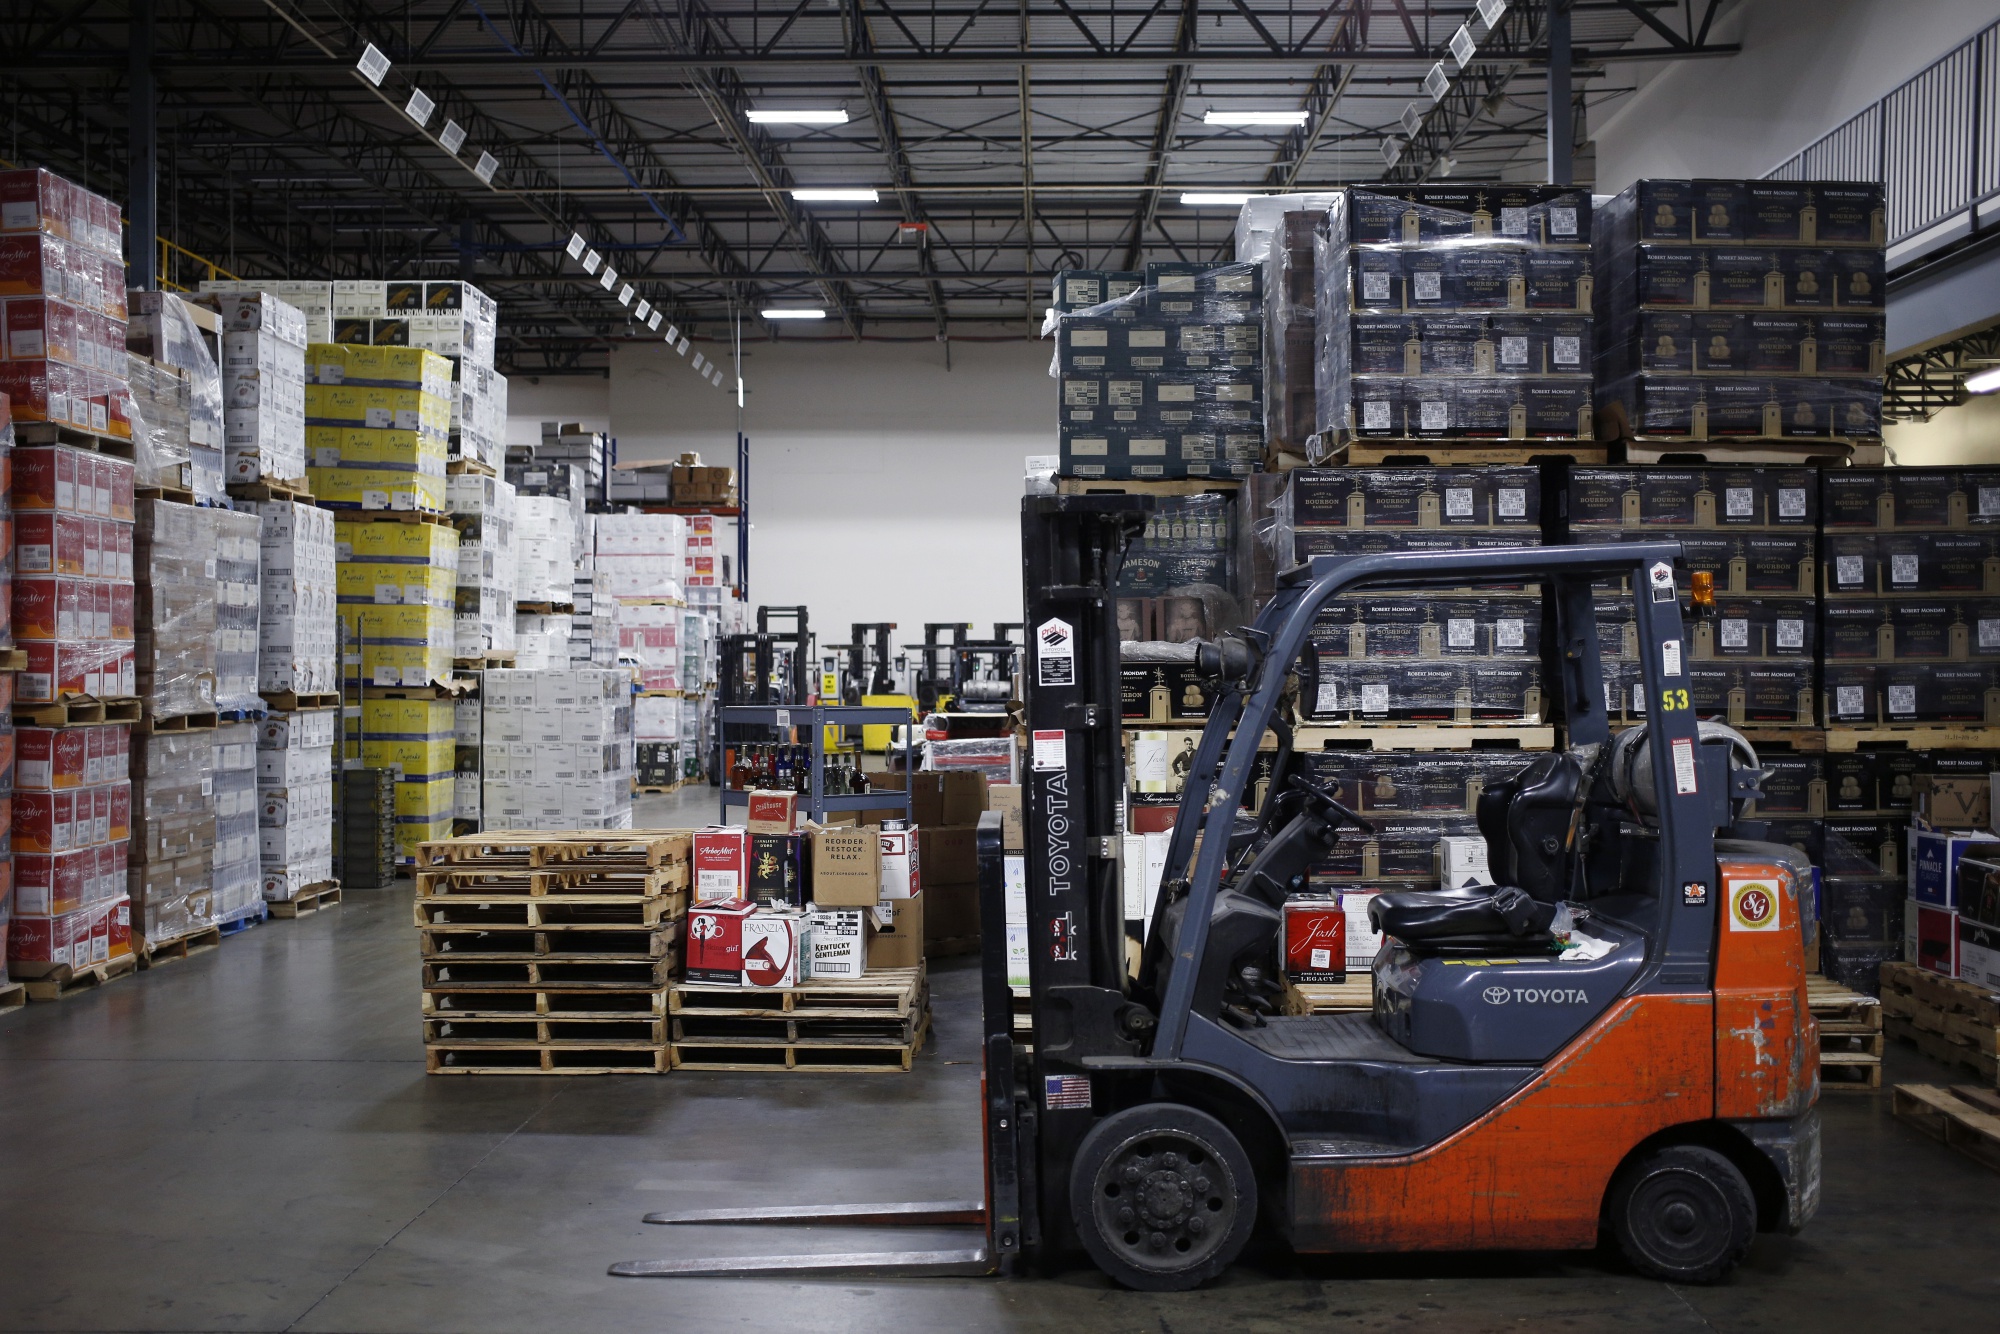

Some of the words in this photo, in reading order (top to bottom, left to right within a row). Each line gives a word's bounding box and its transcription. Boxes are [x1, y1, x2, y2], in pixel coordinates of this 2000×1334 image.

[387, 309, 404, 317] OLD
[404, 309, 422, 317] CROW
[426, 309, 442, 317] OLD
[443, 309, 461, 317] CROW
[461, 539, 481, 548] CROW
[1122, 559, 1160, 569] JAMESON
[458, 613, 479, 621] CROW
[458, 698, 479, 707] CROW
[1662, 689, 1689, 711] 53
[1954, 791, 1980, 814] V
[1047, 772, 1070, 896] TOYOTA
[1920, 859, 1941, 873] PINNACLE
[1685, 884, 1705, 897] SAS
[1743, 893, 1765, 919] SG
[744, 923, 785, 934] FRANZIA
[1291, 916, 1340, 954] Josh
[816, 942, 850, 952] KENTUCKY
[815, 949, 850, 958] GENTLEMAN
[1513, 989, 1589, 1004] TOYOTA
